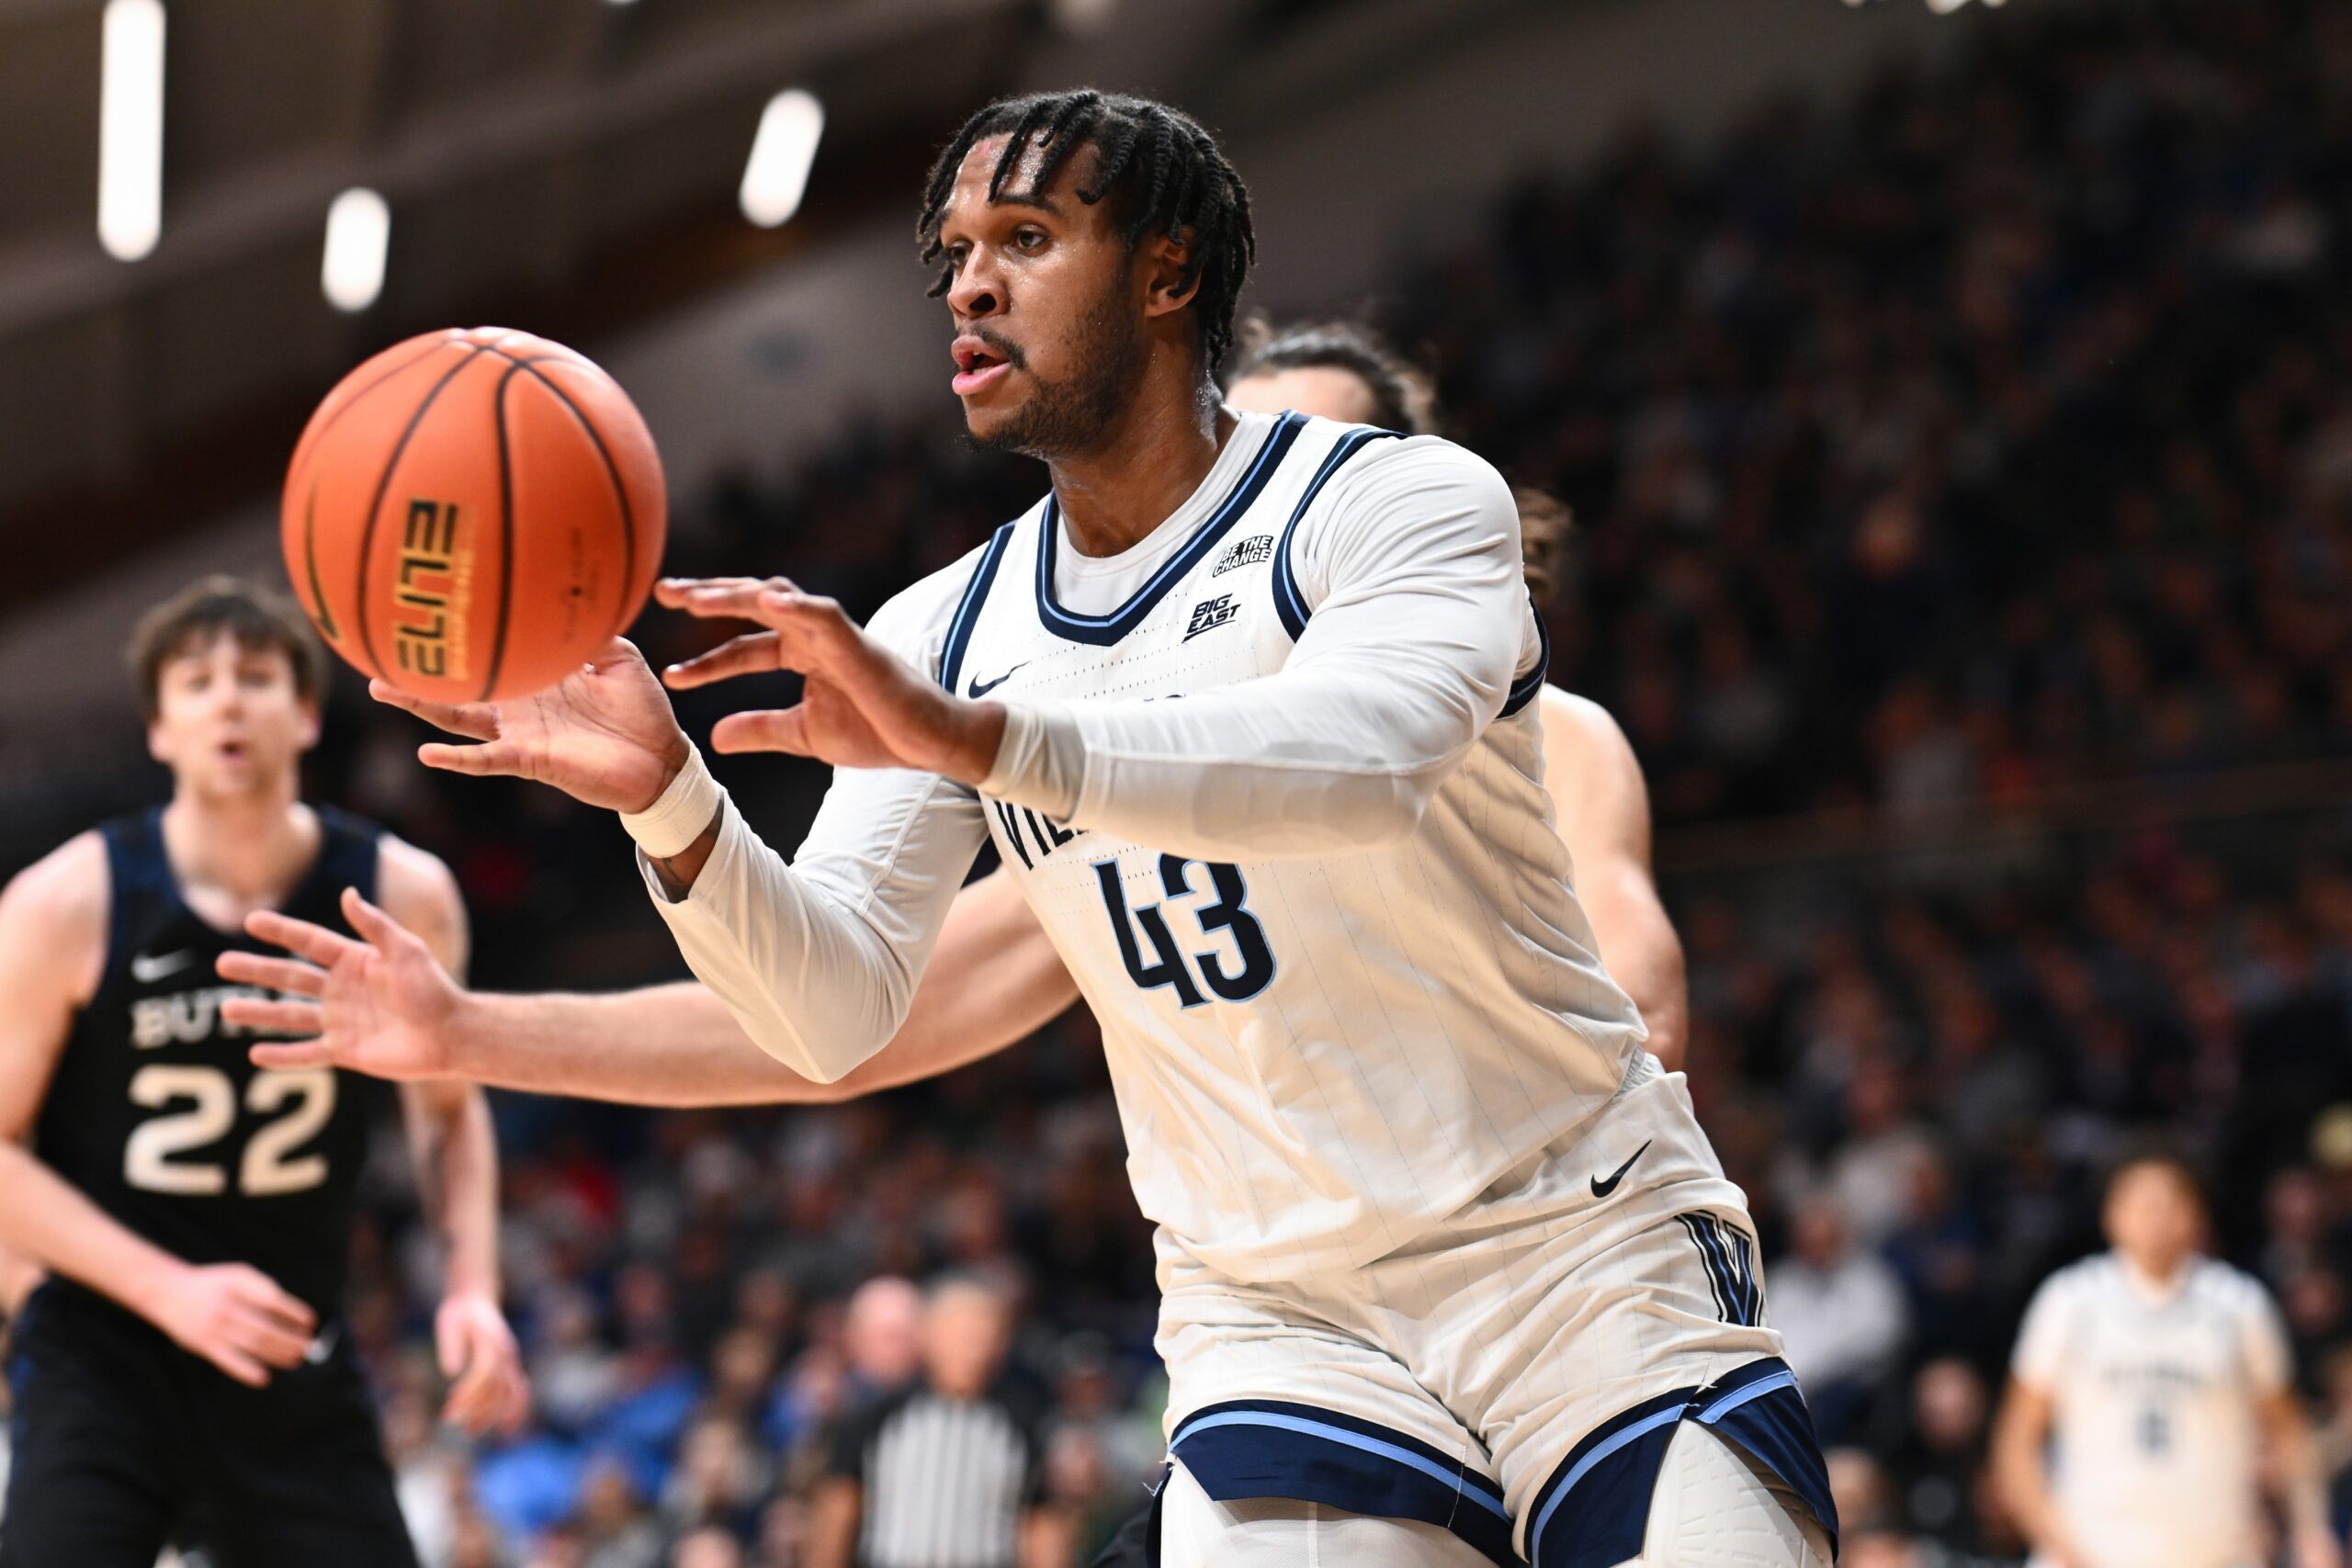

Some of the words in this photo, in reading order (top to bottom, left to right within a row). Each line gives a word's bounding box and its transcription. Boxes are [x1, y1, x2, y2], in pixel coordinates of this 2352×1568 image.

[1213, 548, 1272, 576] CHANGE
[1220, 544, 1239, 561] BE
[1242, 536, 1272, 552] THE
[395, 498, 458, 678] ELITE
[1186, 604, 1242, 634] EAST
[1192, 592, 1233, 619] BIG
[1090, 852, 1277, 1010] 43
[123, 1064, 337, 1198] 22
